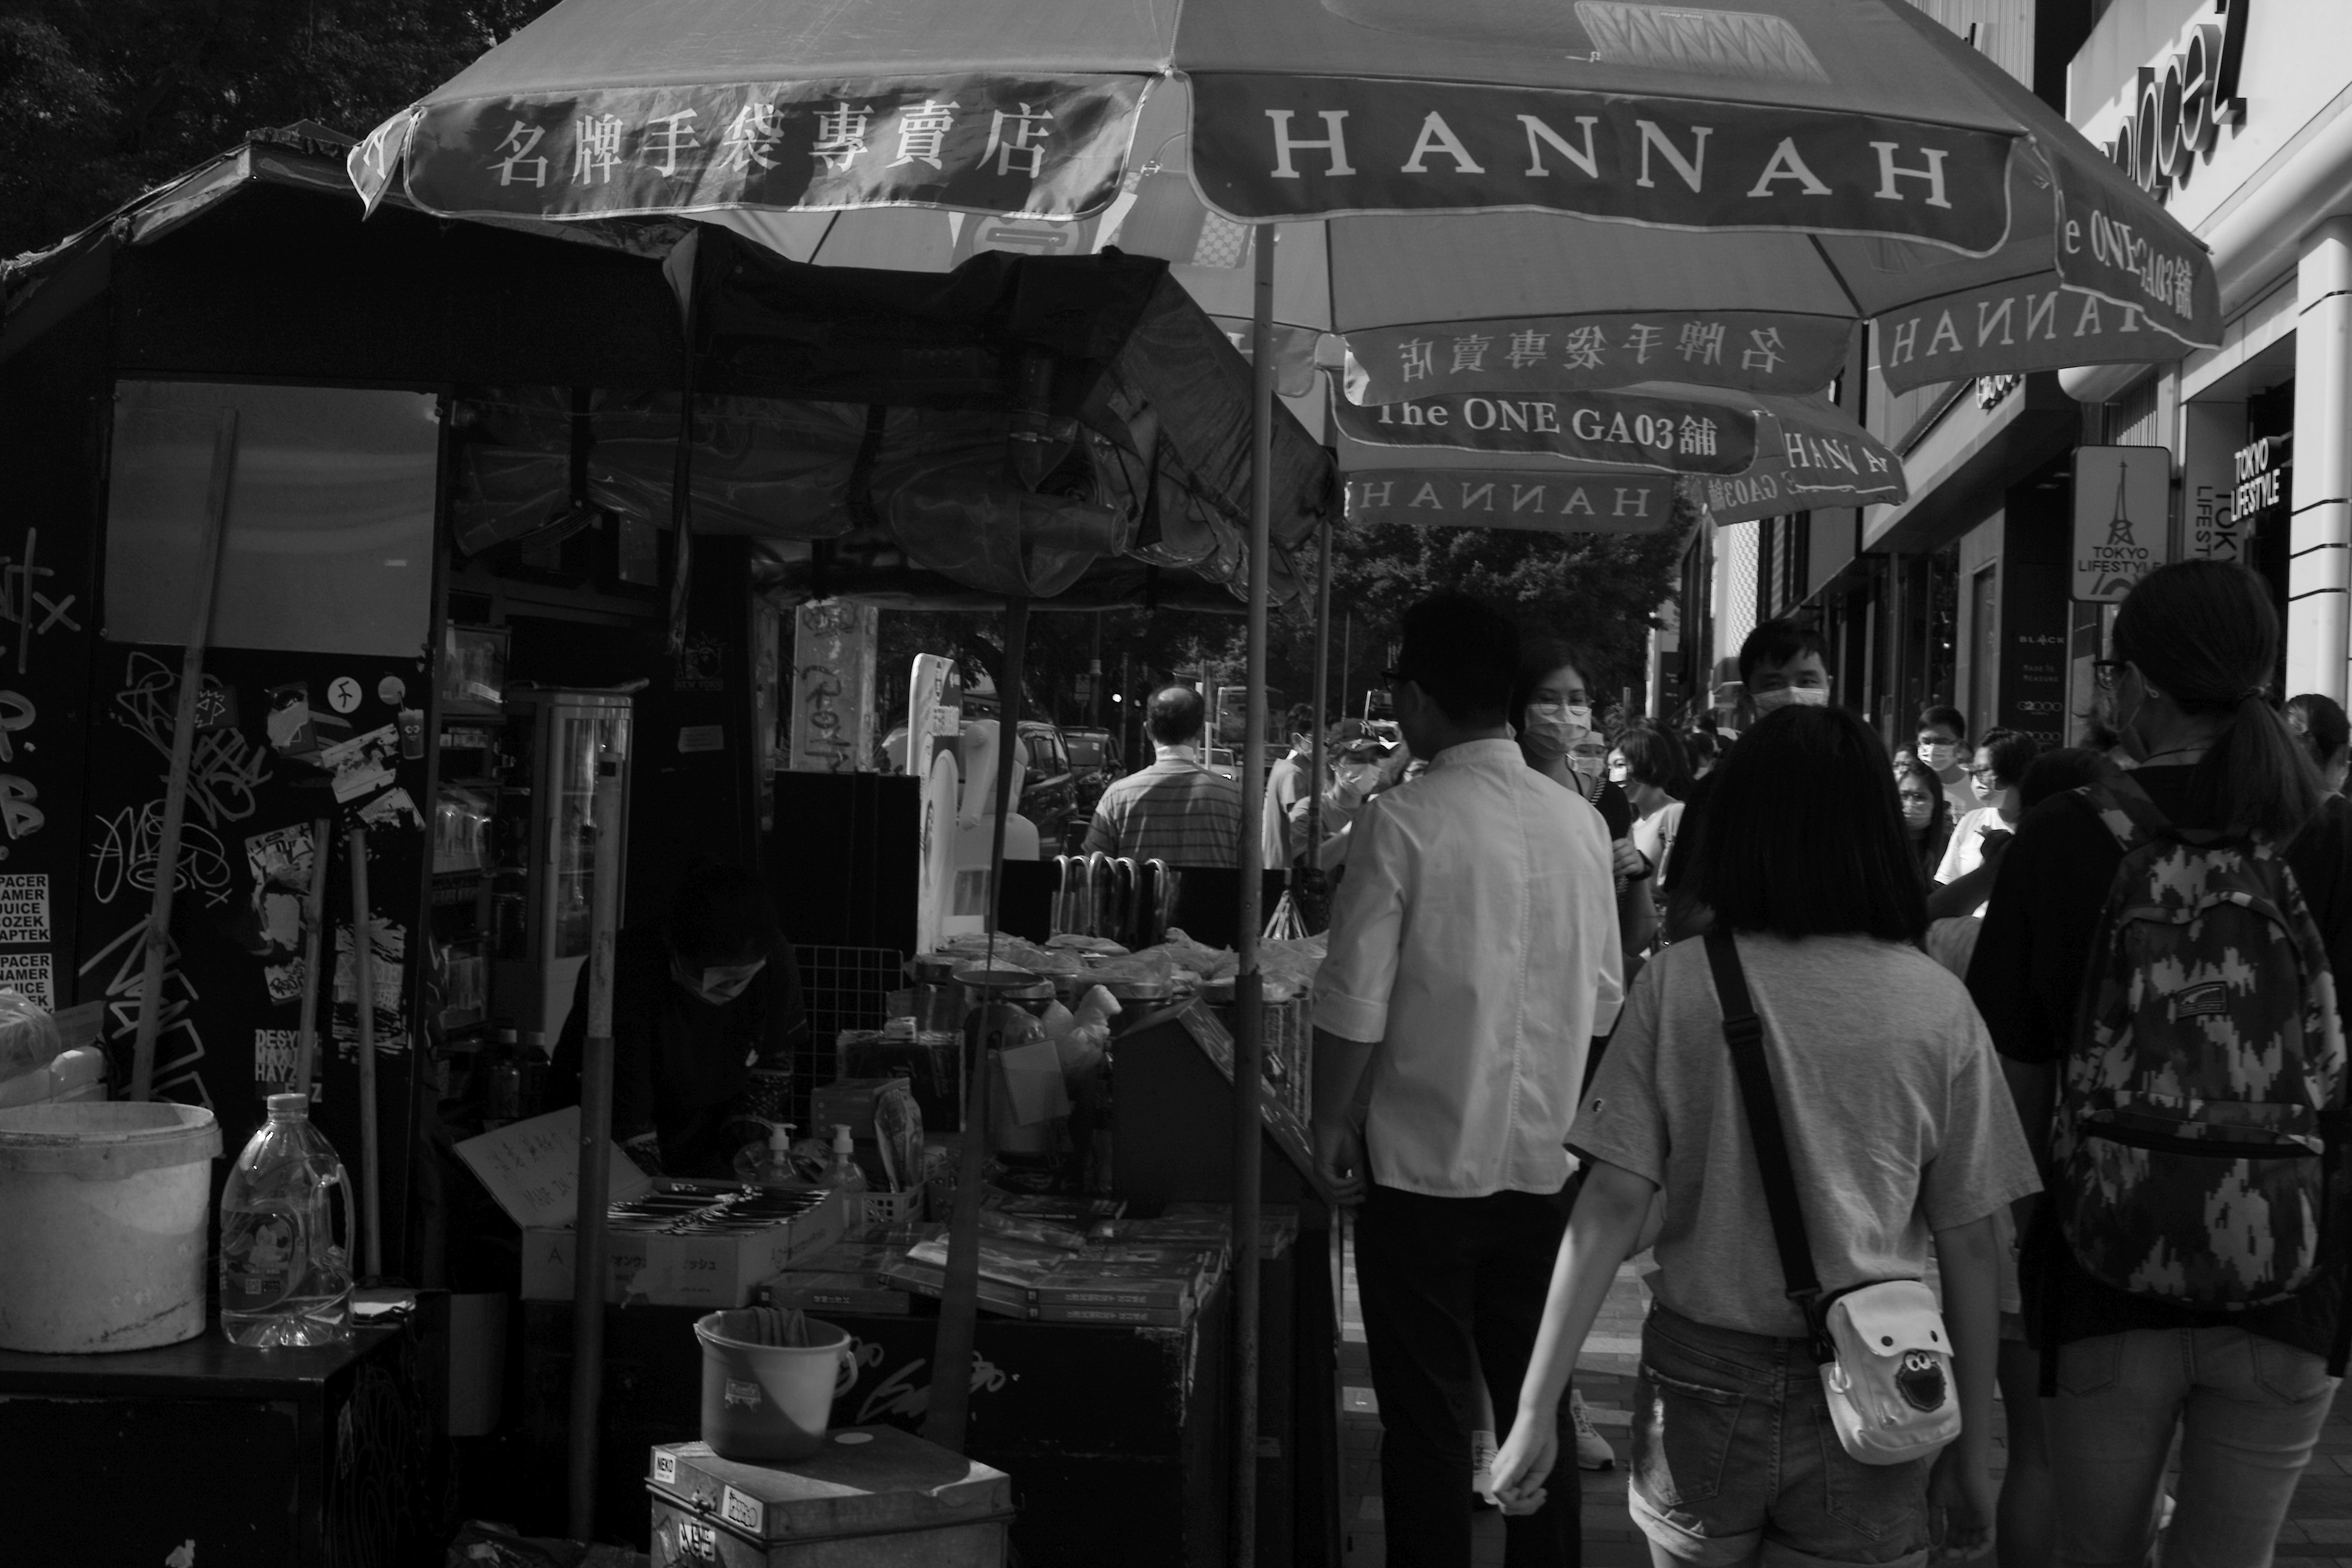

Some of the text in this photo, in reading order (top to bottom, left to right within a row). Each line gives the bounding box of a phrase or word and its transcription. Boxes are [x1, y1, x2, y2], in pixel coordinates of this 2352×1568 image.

[487, 99, 1054, 188] 名牌手袋專賣店
[1264, 109, 1952, 209] HANNAH
[2091, 210, 2140, 275] ONE
[1377, 398, 1717, 457] The ONE GA03舖
[2234, 437, 2269, 484] TOKYO
[2230, 468, 2281, 522] LIFESTYLE
[2093, 546, 2149, 559] TOKYO
[0, 916, 44, 927] OZEK
[1, 956, 49, 967] PACER
